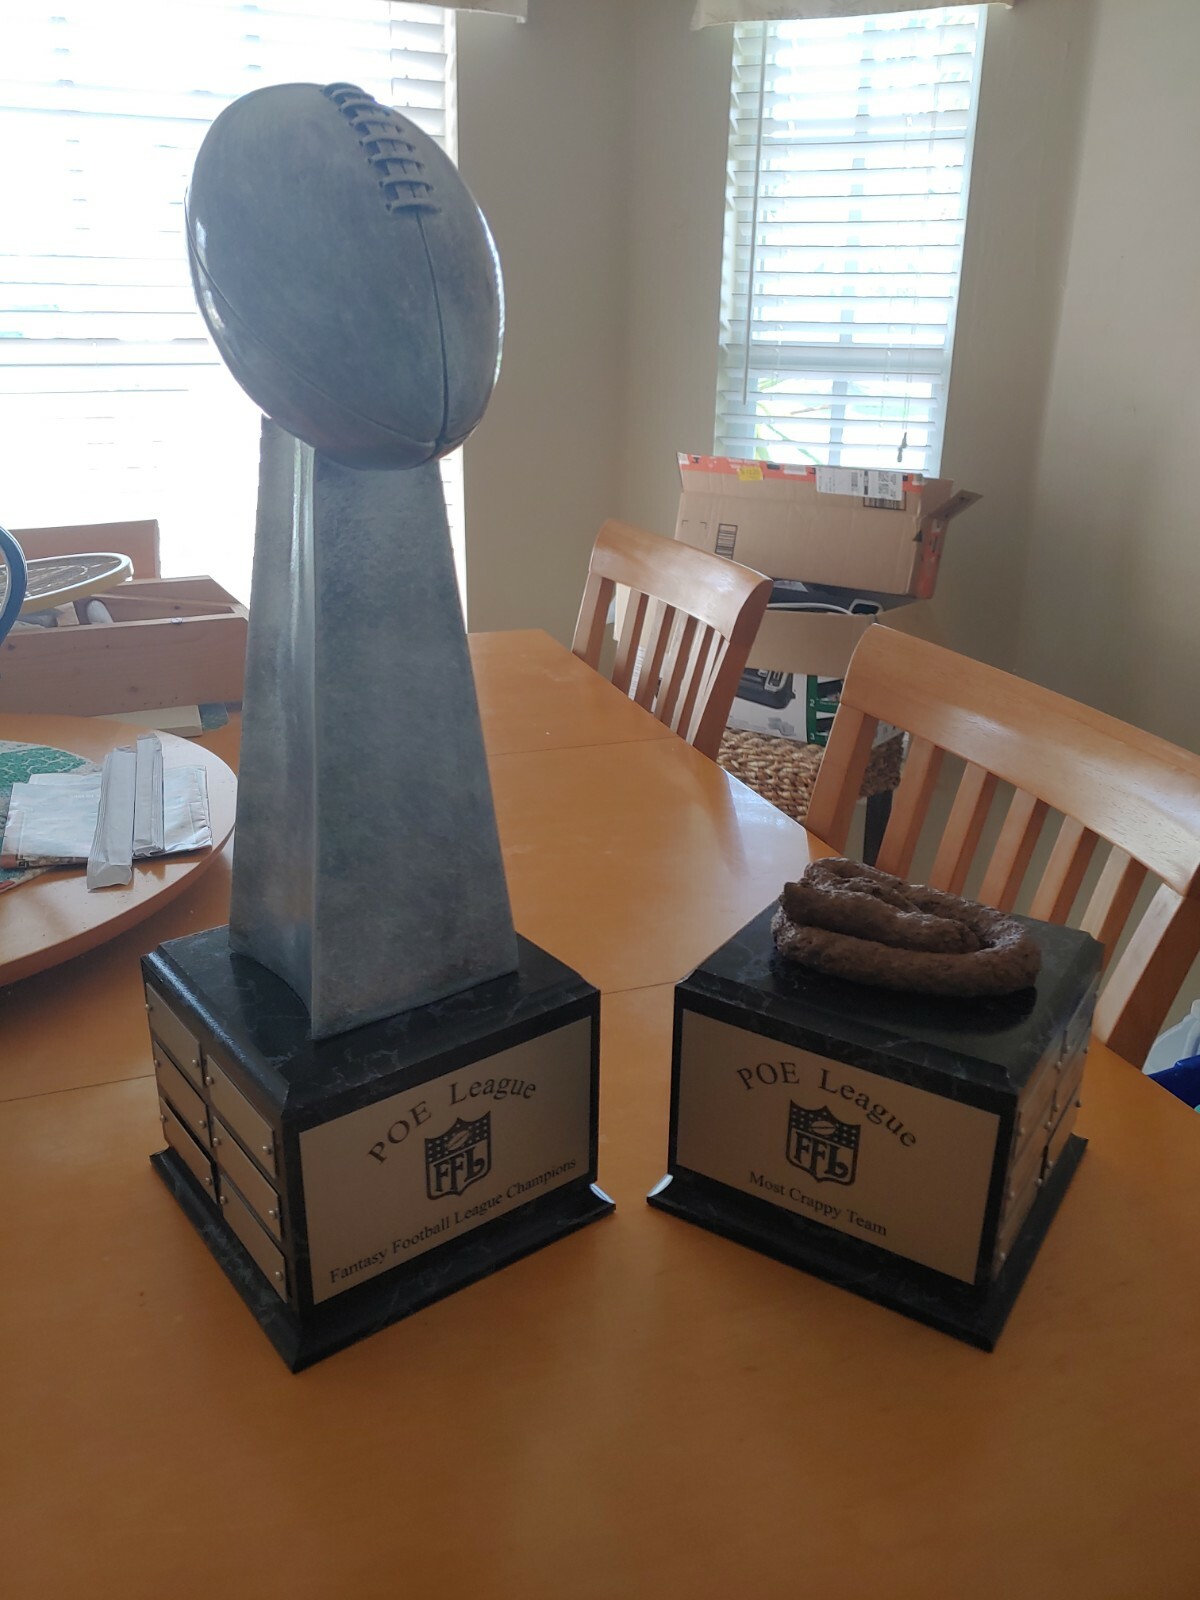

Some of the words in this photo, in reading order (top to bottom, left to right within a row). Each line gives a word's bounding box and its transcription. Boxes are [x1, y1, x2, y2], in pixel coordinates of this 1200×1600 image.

[368, 1100, 432, 1164] POE
[449, 1077, 537, 1106] League
[736, 1061, 800, 1091] POE
[818, 1068, 917, 1148] League
[329, 1248, 388, 1283] Fantasy
[392, 1218, 450, 1254] Football
[454, 1194, 502, 1225] League
[506, 1158, 577, 1199] Champions
[749, 1170, 785, 1196] Most
[789, 1187, 842, 1219] Crappy
[846, 1208, 888, 1236] Team
